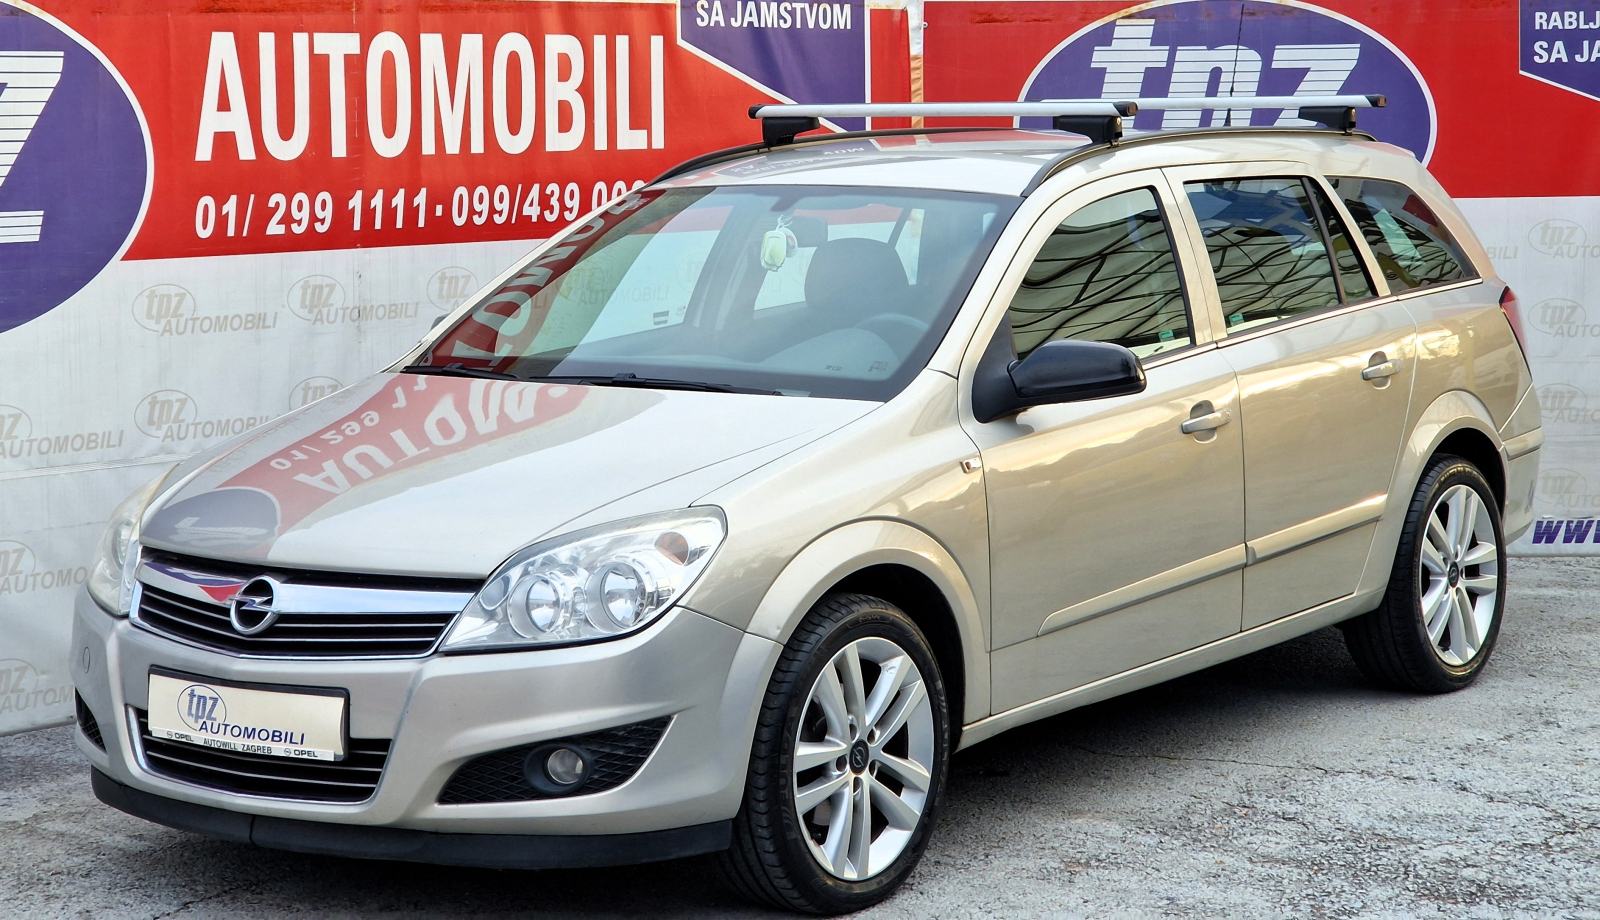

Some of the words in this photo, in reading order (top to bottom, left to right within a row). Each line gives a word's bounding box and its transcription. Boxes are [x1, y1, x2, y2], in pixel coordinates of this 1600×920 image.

[696, 0, 725, 28] SA
[730, 1, 852, 30] JAMSTVOM
[1533, 40, 1569, 64] SA
[194, 31, 665, 162] AUTOMOBILI
[195, 193, 255, 239] 01/
[265, 190, 333, 236] 299
[1538, 222, 1576, 250] tpz
[144, 288, 188, 325] tpz
[299, 280, 337, 314] tpz
[160, 311, 279, 337] AUTOMOBILI
[312, 302, 420, 326] AUTOMOBILI
[1538, 301, 1576, 329] tpz
[147, 395, 188, 431] tpz
[187, 688, 219, 724] tpz
[174, 732, 195, 743] OPEL
[203, 737, 238, 751] AUTOWILL
[241, 742, 273, 755] ZAGREB
[293, 750, 319, 759] OPEL
[198, 720, 306, 746] AUTOMOBILI
